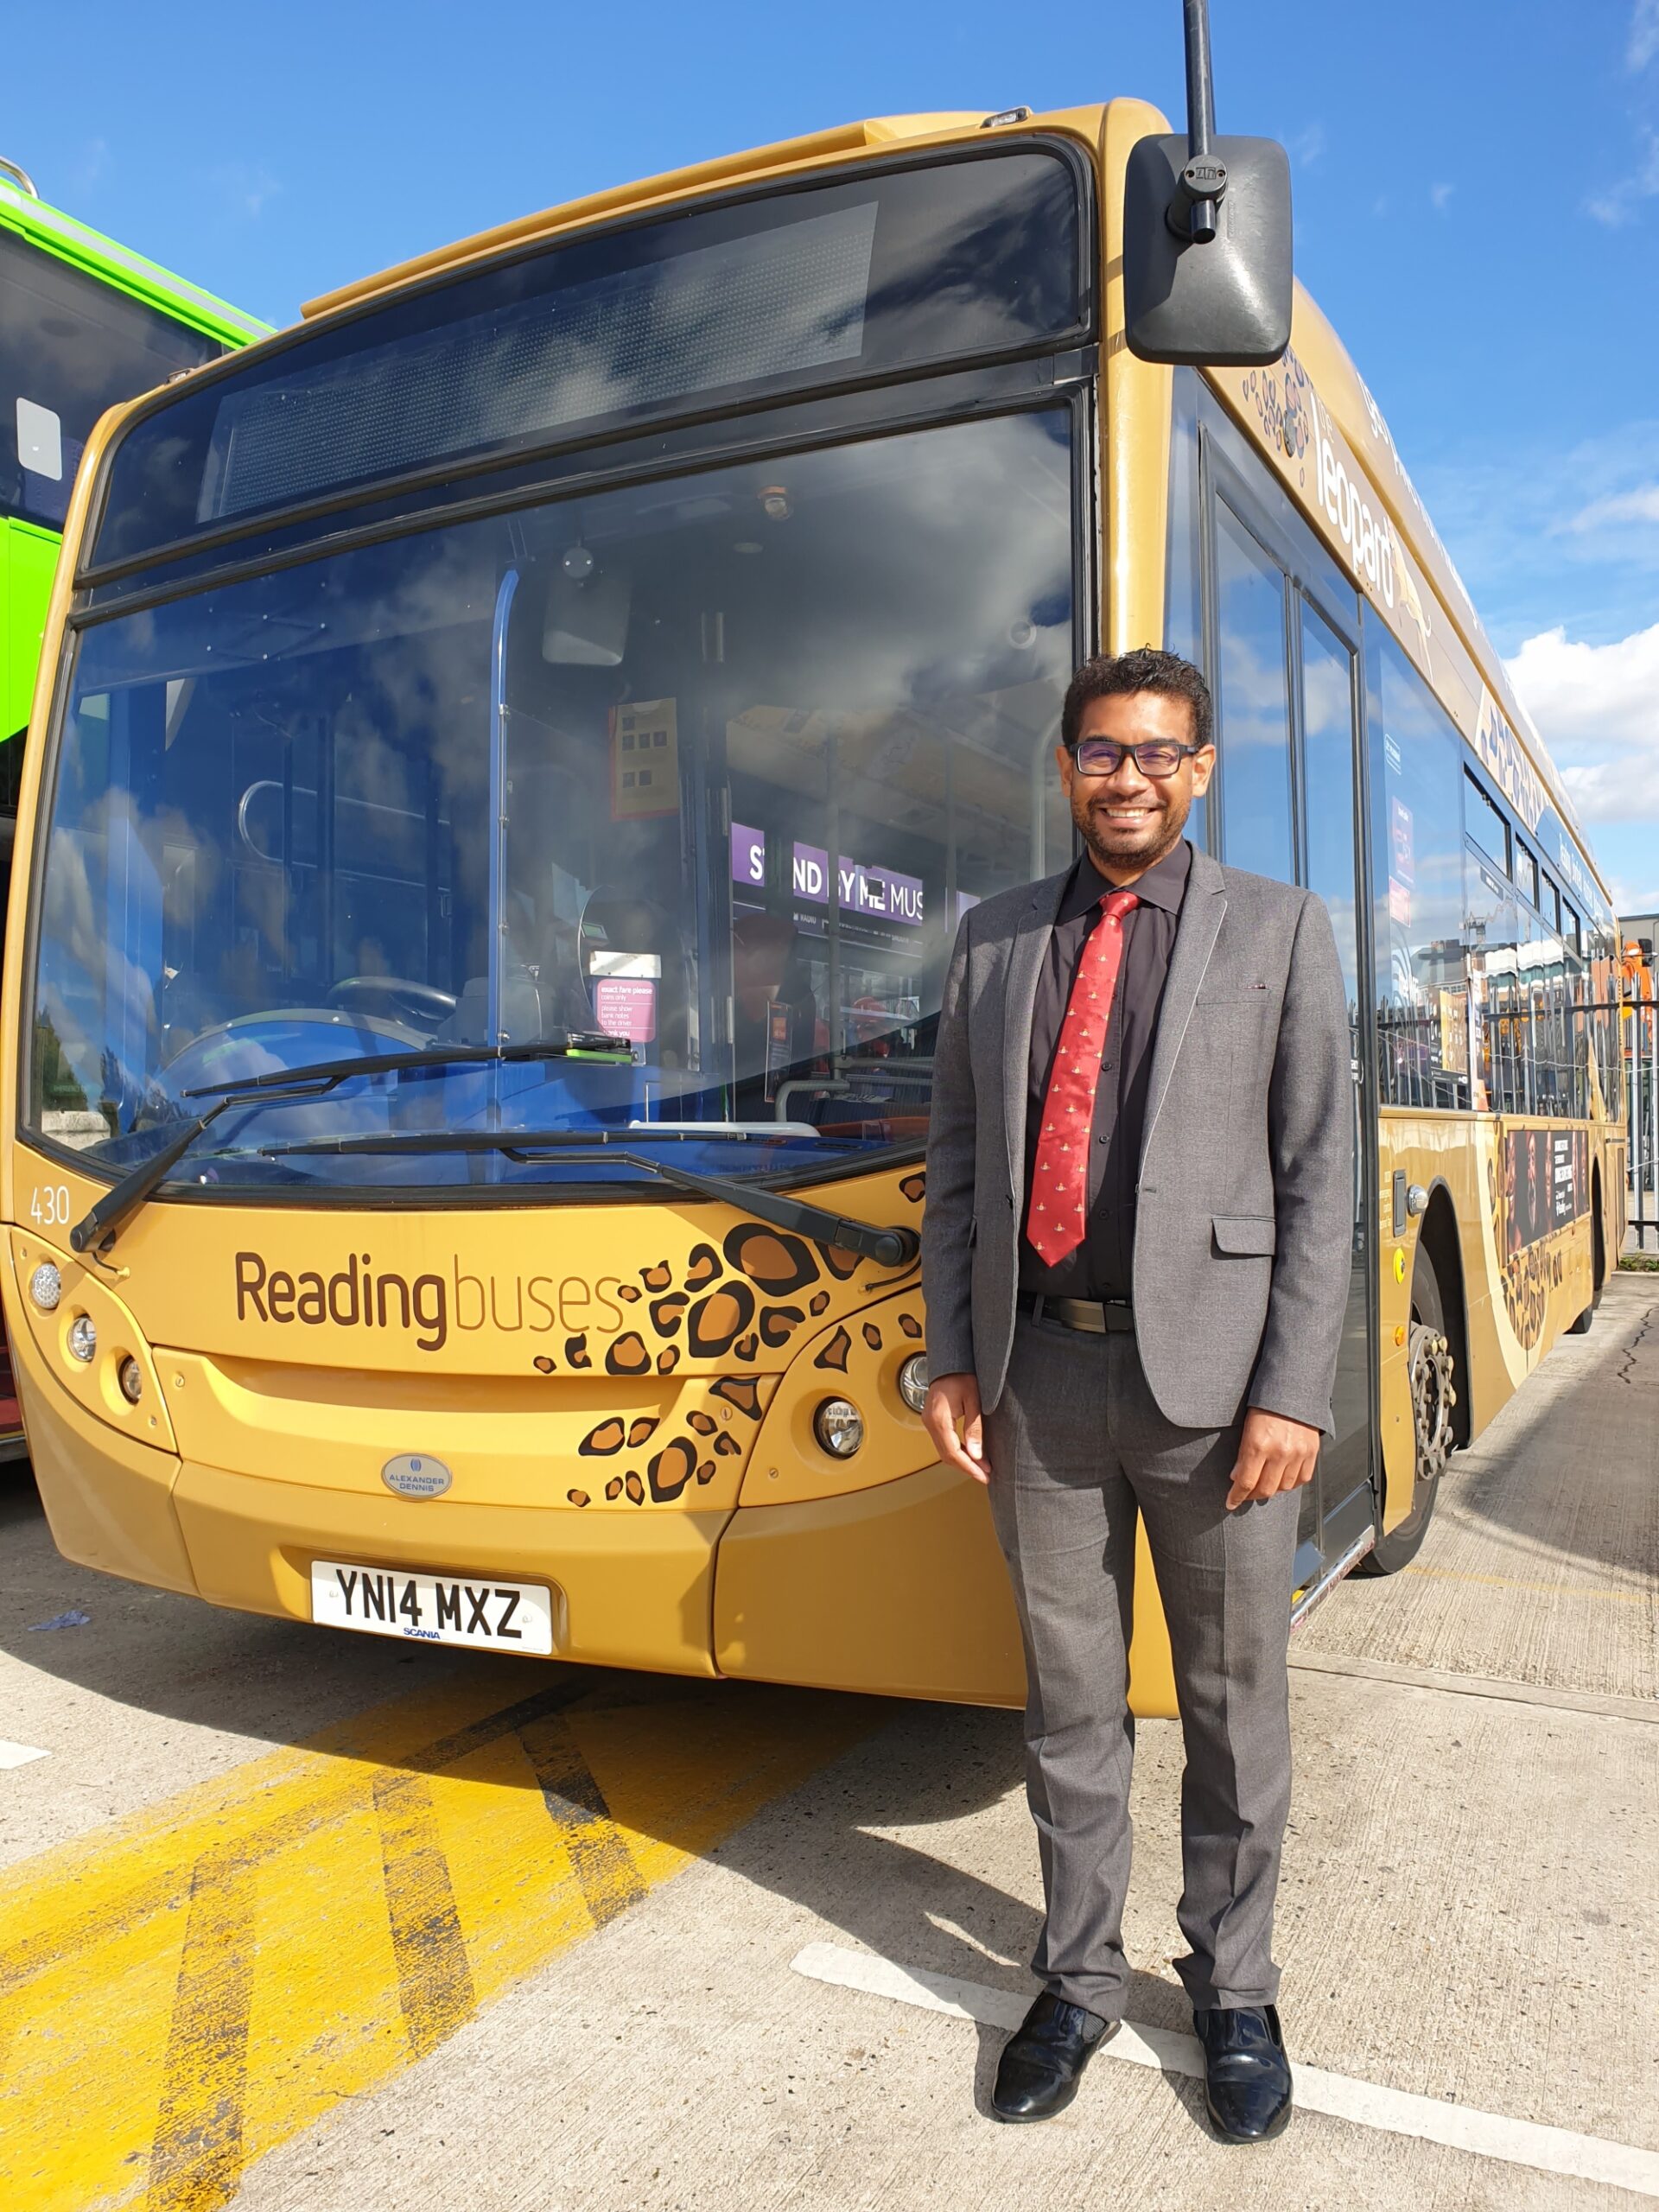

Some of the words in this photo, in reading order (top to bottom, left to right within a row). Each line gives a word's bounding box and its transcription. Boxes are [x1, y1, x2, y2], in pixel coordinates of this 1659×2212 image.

[1310, 391, 1394, 609] leopard
[749, 844, 822, 894] SND
[30, 1185, 69, 1224] 430
[390, 1474, 444, 1485] ALEXANDER
[399, 1483, 435, 1492] DENNIS
[335, 1568, 423, 1627] YN14
[435, 1582, 523, 1639] MXZ
[403, 1627, 441, 1640] SCANIA
